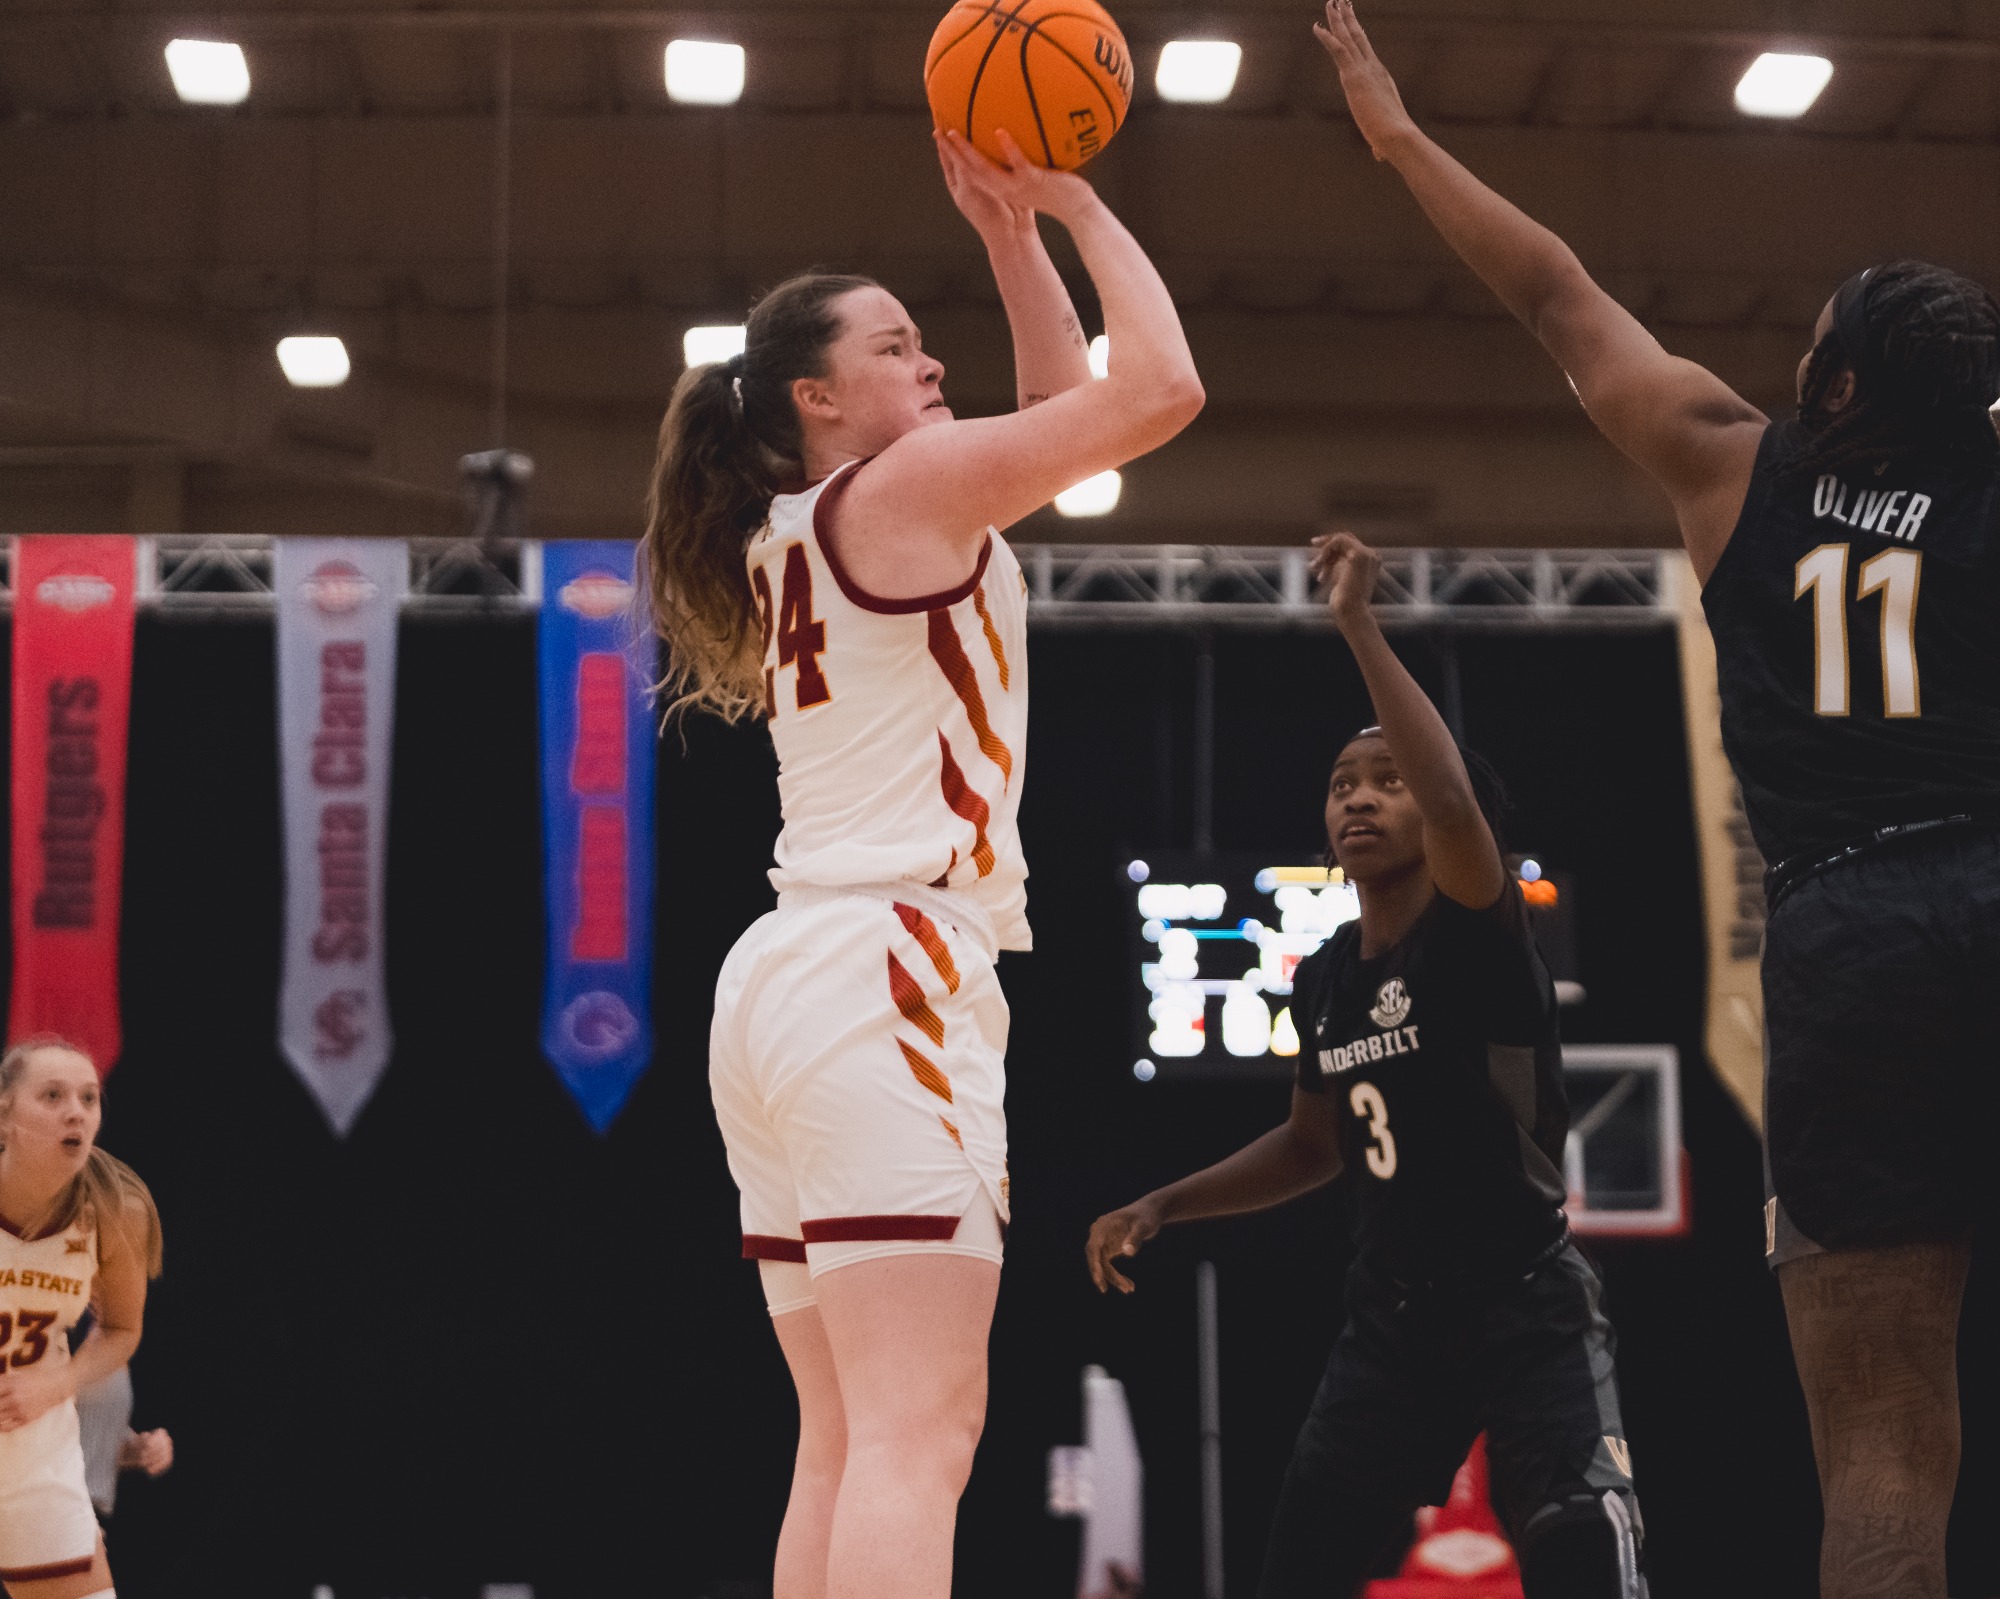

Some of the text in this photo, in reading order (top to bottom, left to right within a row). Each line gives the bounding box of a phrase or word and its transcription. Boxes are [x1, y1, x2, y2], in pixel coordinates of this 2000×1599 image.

[1814, 474, 1932, 543] OLIVER
[1794, 542, 1923, 719] 11
[310, 639, 367, 789] Clara
[31, 676, 104, 929] Rutgers
[310, 802, 368, 965] Santa
[1380, 979, 1404, 1015] SEC
[1350, 1081, 1398, 1181] 3
[20, 1269, 83, 1297] STATE
